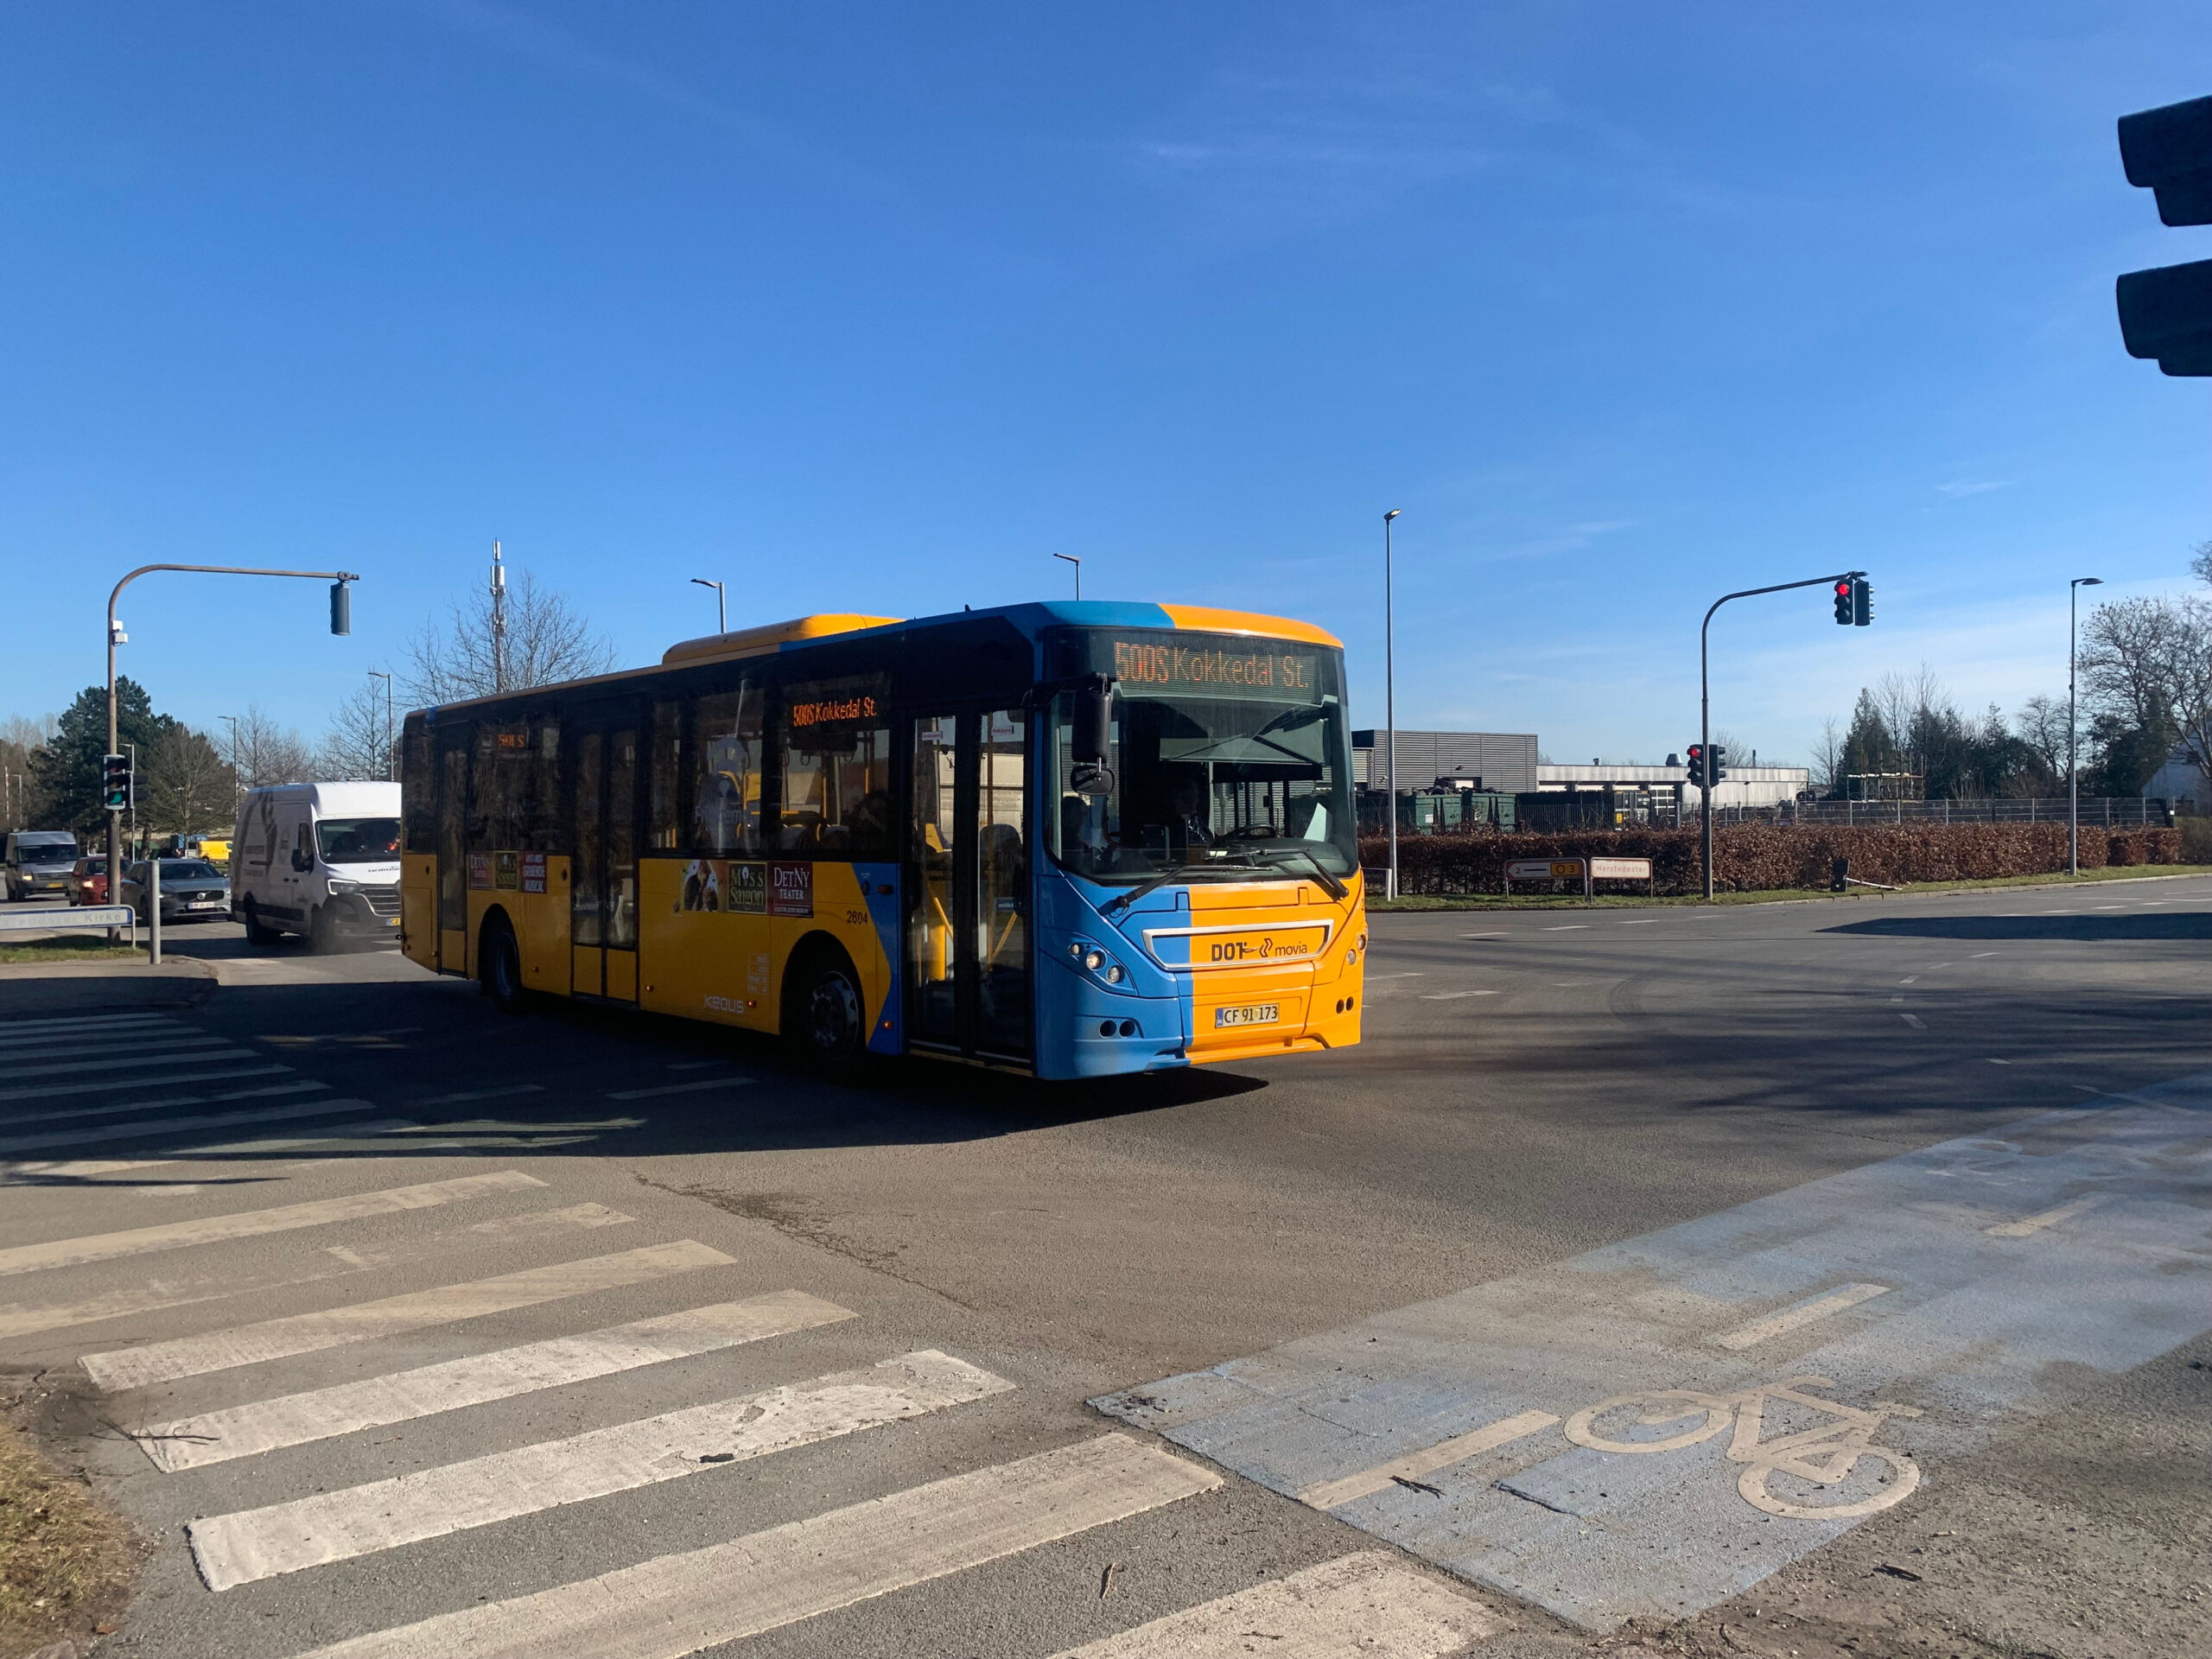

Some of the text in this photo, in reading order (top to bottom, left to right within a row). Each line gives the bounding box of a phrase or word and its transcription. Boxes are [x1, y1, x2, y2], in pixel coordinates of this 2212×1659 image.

[1115, 641, 1308, 688] 500S Kokkedal St.
[793, 703, 815, 727] 500S
[816, 698, 861, 721] Kokkedal
[779, 888, 804, 899] TEATER
[85, 912, 121, 923] Kirke
[847, 910, 868, 925] 2604
[1211, 941, 1307, 962] DOT movia
[1224, 1009, 1239, 1023] CF
[1242, 1007, 1254, 1022] 91
[1258, 1006, 1278, 1020] 173
